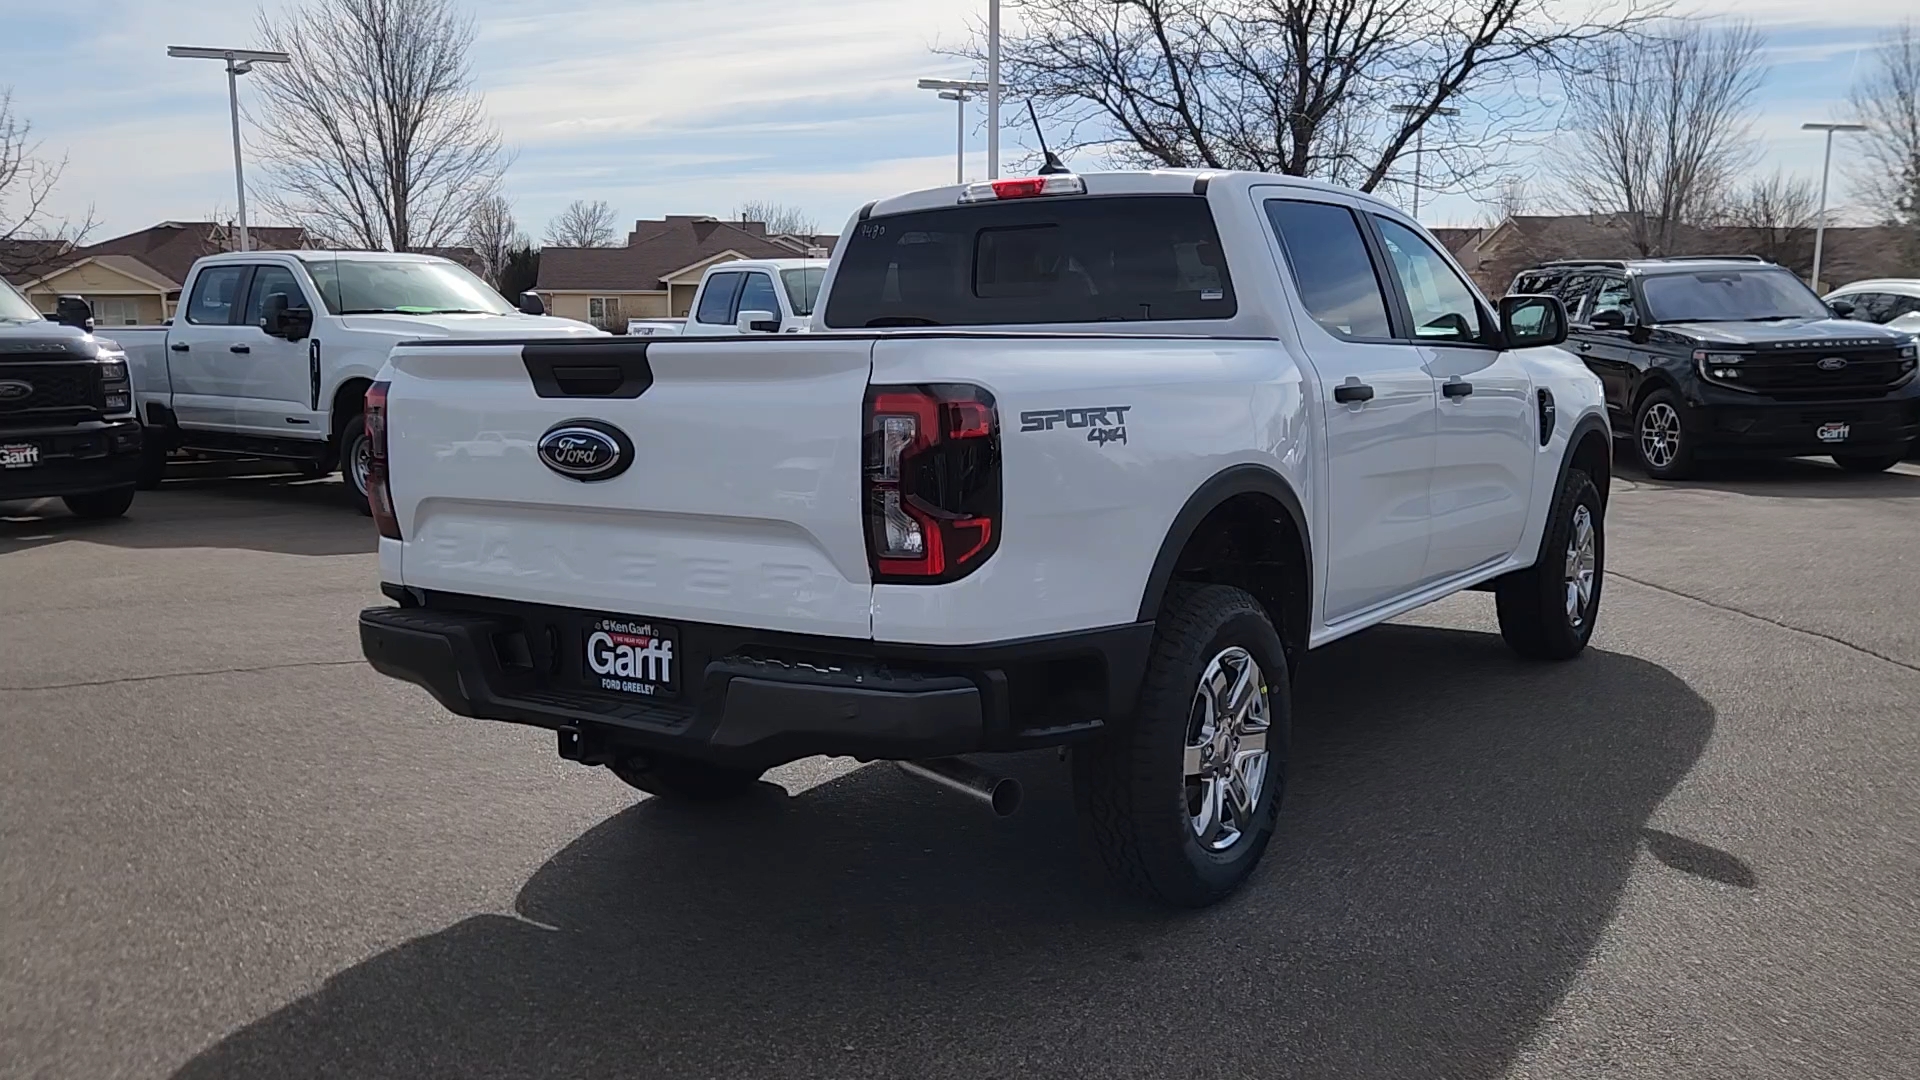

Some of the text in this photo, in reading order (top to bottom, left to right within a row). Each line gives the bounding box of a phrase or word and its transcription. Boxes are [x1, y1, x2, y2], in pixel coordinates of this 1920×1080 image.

[1020, 405, 1132, 433] SPORT
[1816, 425, 1850, 440] Garff
[0, 446, 39, 465] Garff
[554, 437, 598, 464] Ford
[610, 620, 652, 636] Ken Garff
[587, 631, 673, 682] Garff
[602, 678, 655, 696] FORD GREELEY
